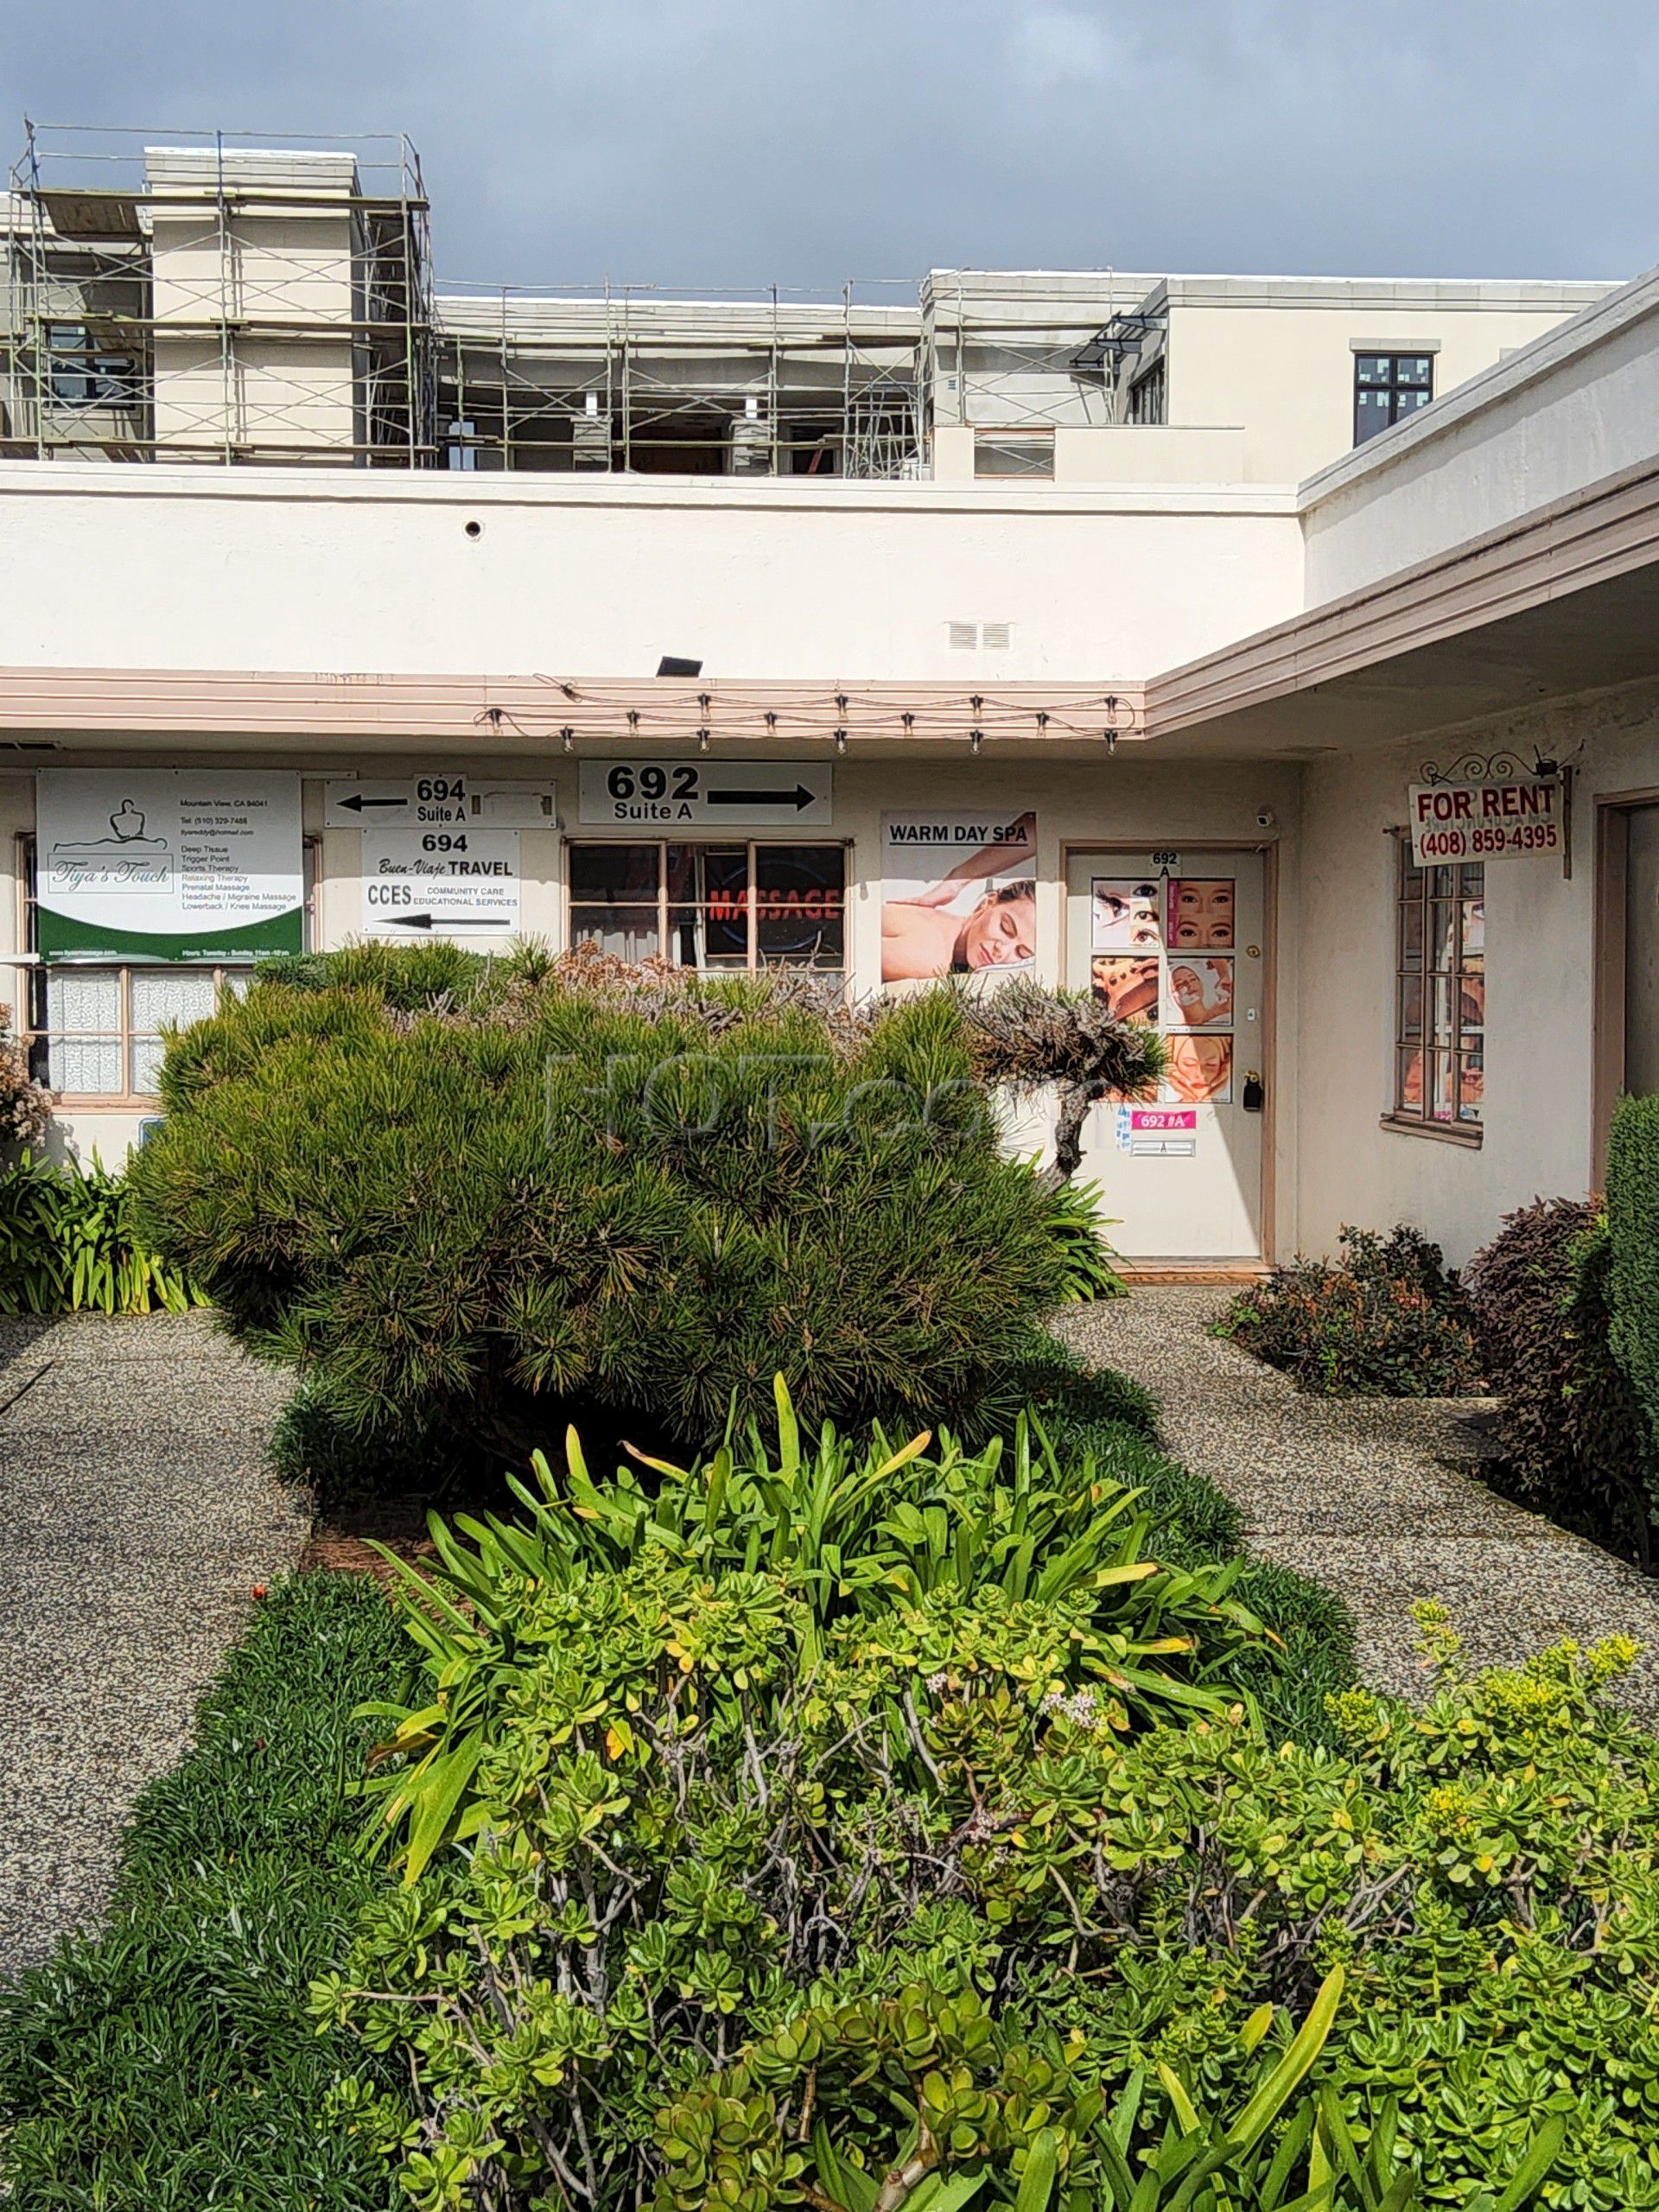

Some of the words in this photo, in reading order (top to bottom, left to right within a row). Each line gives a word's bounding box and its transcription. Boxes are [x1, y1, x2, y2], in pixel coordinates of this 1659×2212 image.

[417, 779, 466, 801] 694
[607, 766, 698, 800] 692
[614, 803, 671, 819] Suite
[677, 803, 692, 819] A
[1418, 791, 1472, 822] FOR
[1482, 785, 1554, 817] RENT
[194, 817, 213, 825] (510)
[417, 806, 452, 821] Suite
[455, 807, 466, 821] A
[890, 825, 949, 841] WARM
[954, 826, 988, 842] DAY
[992, 826, 1027, 842] SPA
[1420, 830, 1466, 858] (408)
[1472, 824, 1556, 853] 859-4395
[422, 835, 467, 853] 694
[1153, 853, 1177, 864] 692
[52, 861, 109, 892] Tiya's
[113, 861, 169, 883] Touch
[378, 859, 446, 879] Buen-Viaje
[448, 861, 513, 876] TRAVEL
[1160, 866, 1170, 878] A
[368, 885, 411, 906] CCES
[427, 887, 478, 896] COMMUNITY
[480, 887, 505, 896] CARE
[413, 897, 474, 906] EDUCATIONAL
[476, 898, 518, 906] SERVICES
[709, 889, 839, 920] MASSAGE
[1141, 1116, 1165, 1127] 692
[1167, 1115, 1185, 1127] #A
[1160, 1141, 1166, 1153] A
